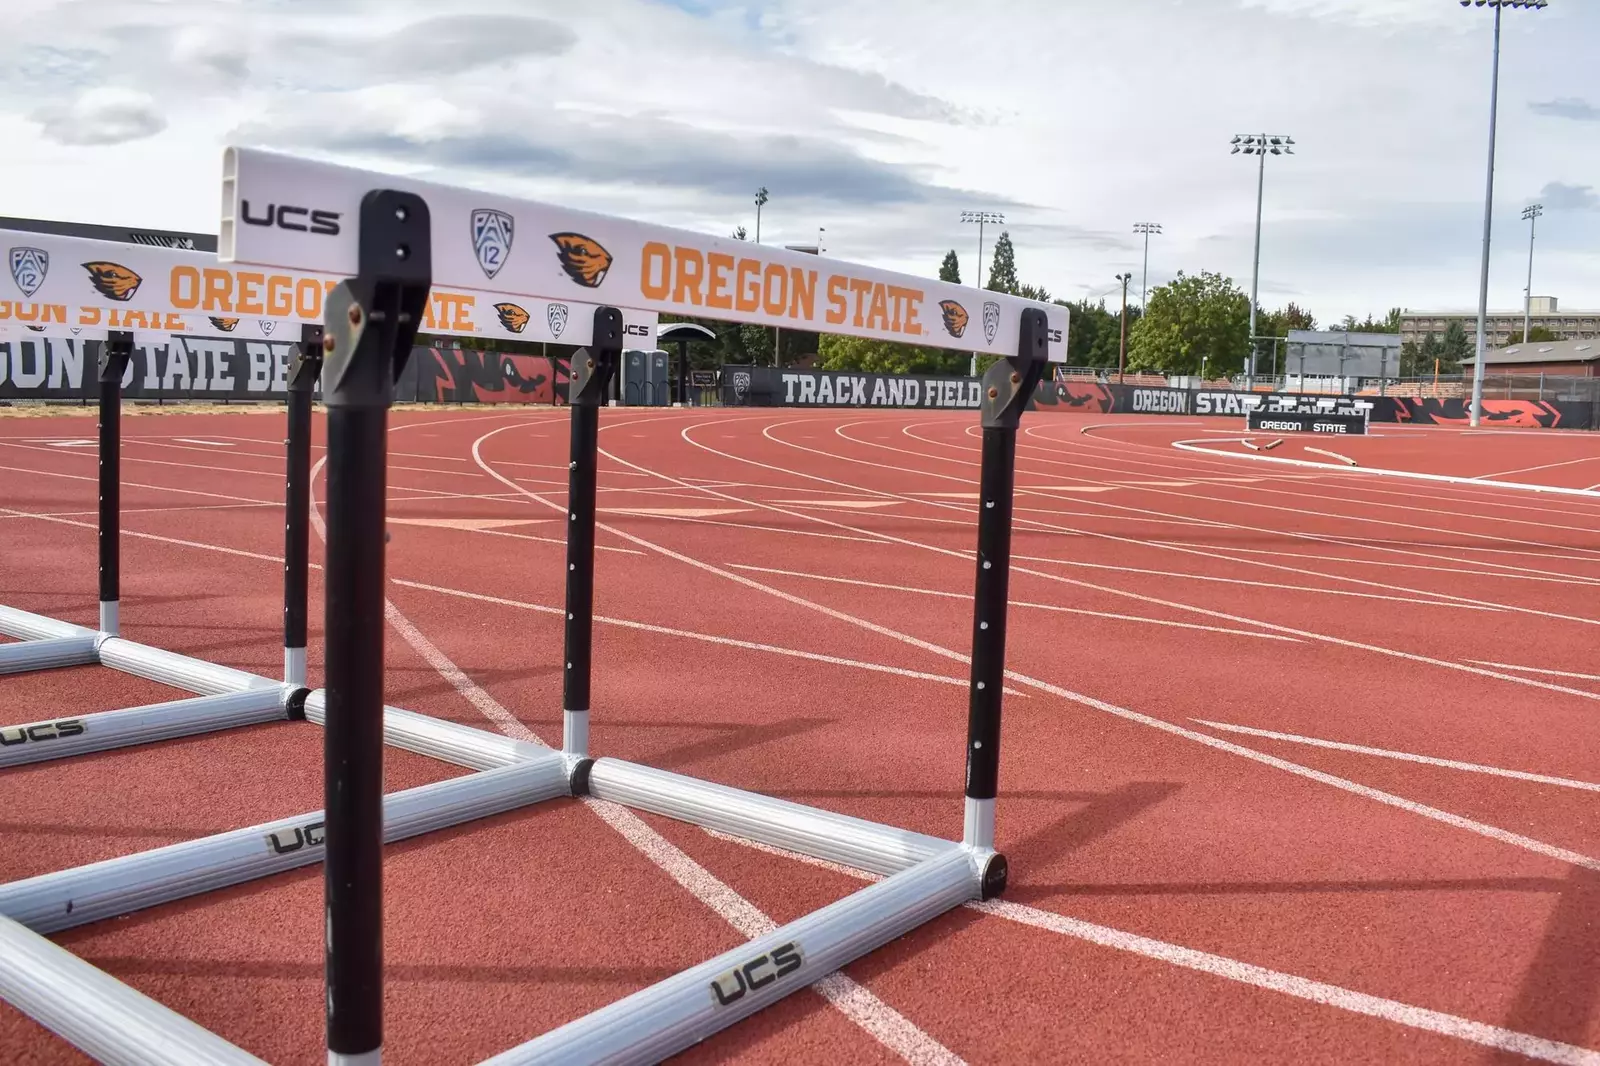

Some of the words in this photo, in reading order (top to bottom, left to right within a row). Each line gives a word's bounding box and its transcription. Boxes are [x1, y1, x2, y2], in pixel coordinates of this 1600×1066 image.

[241, 199, 340, 236] UCS
[484, 246, 499, 264] 12
[22, 273, 36, 287] 12
[169, 265, 337, 319] OREGO
[641, 241, 818, 321] OREGON
[826, 274, 924, 336] STATE
[0, 338, 86, 389] ON
[120, 337, 235, 391] TATE
[782, 374, 867, 404] TRACK
[870, 378, 920, 406] AND
[924, 380, 982, 407] FIELD
[1132, 389, 1188, 413] OREGON
[1260, 420, 1302, 431] OREGON
[1313, 423, 1347, 433] STATE
[0, 719, 85, 746] UCS
[270, 821, 325, 853] UC
[711, 943, 802, 1006] UCS
